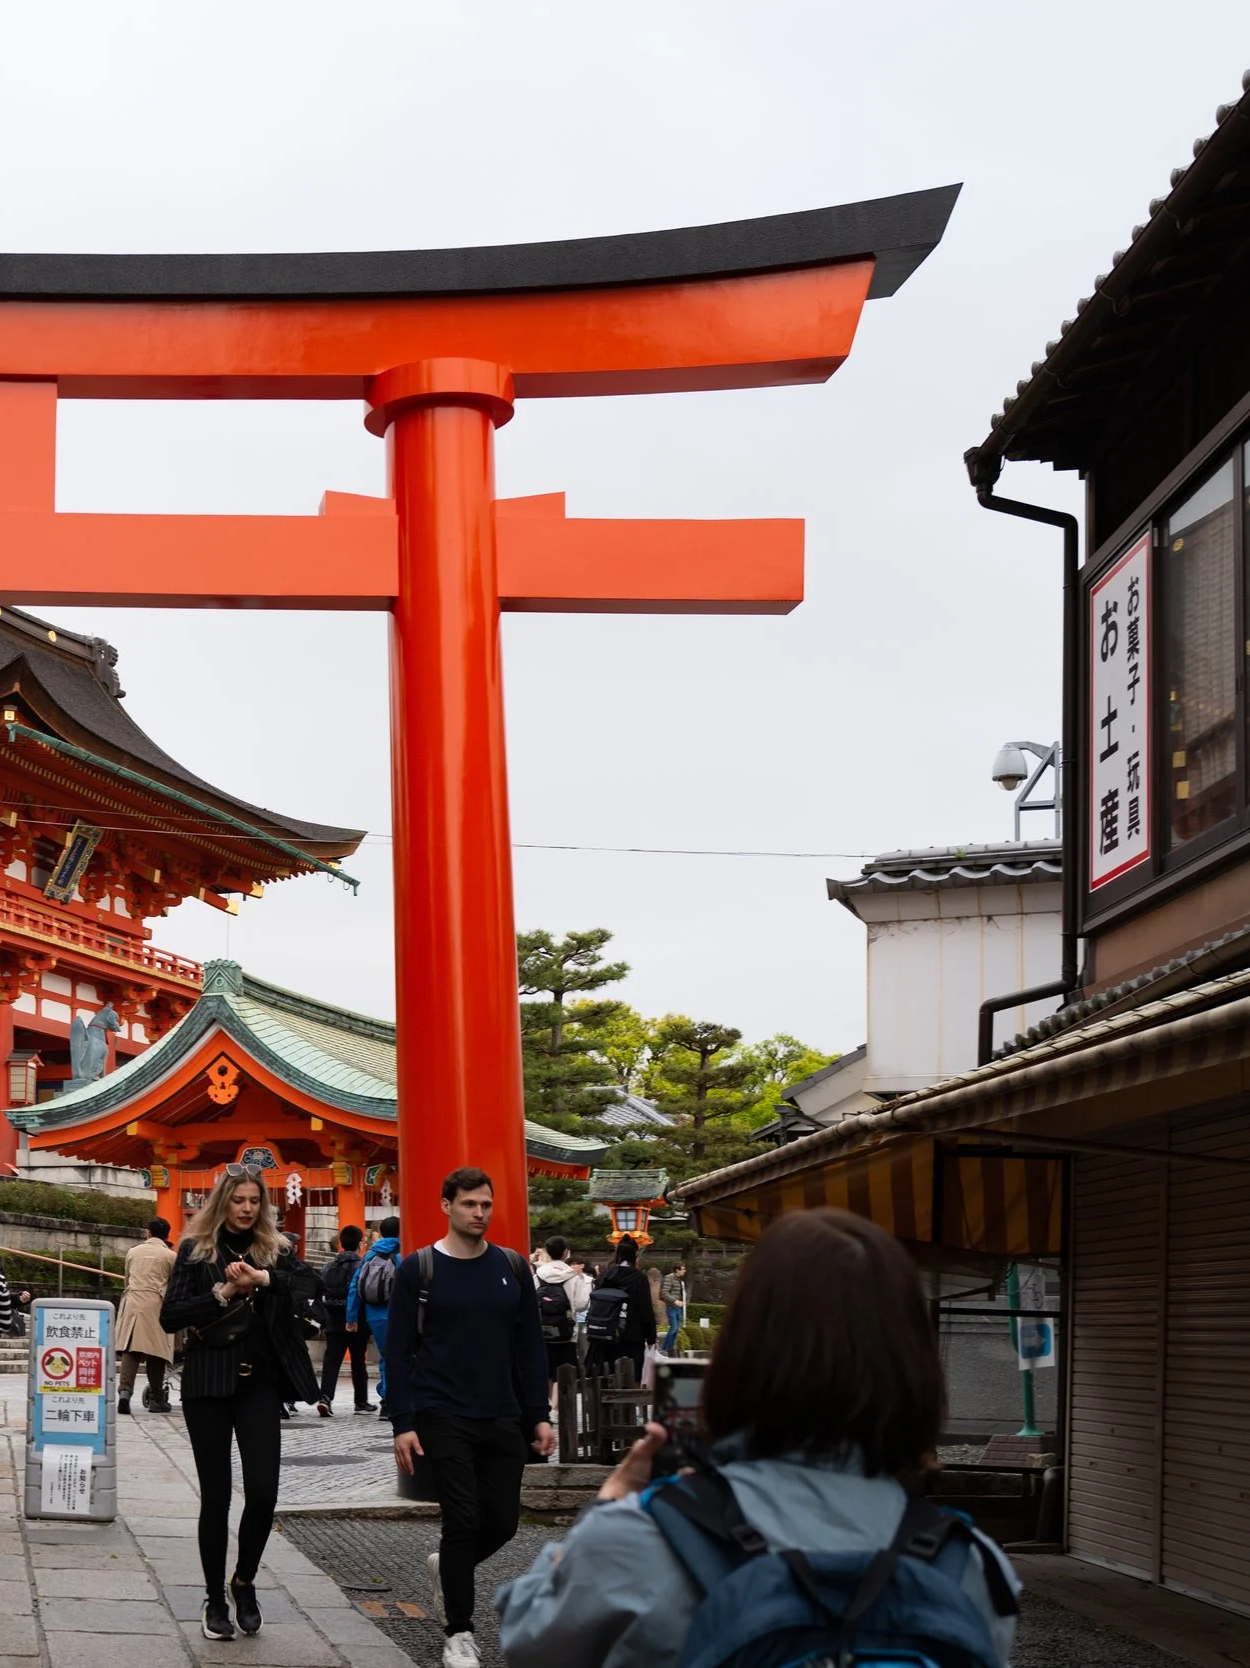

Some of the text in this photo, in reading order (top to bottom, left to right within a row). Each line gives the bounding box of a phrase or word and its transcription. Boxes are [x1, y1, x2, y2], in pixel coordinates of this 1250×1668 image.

[1126, 575, 1140, 841] お菓子・玩具
[1099, 599, 1119, 857] お土産
[53, 1313, 86, 1321] これより先
[46, 1325, 97, 1339] 飲食禁止
[78, 1359, 98, 1368] ペット
[78, 1376, 97, 1385] 禁止
[52, 1396, 86, 1404] これより先
[45, 1409, 96, 1422] 二輪下車
[79, 1468, 87, 1495] お知らせ
